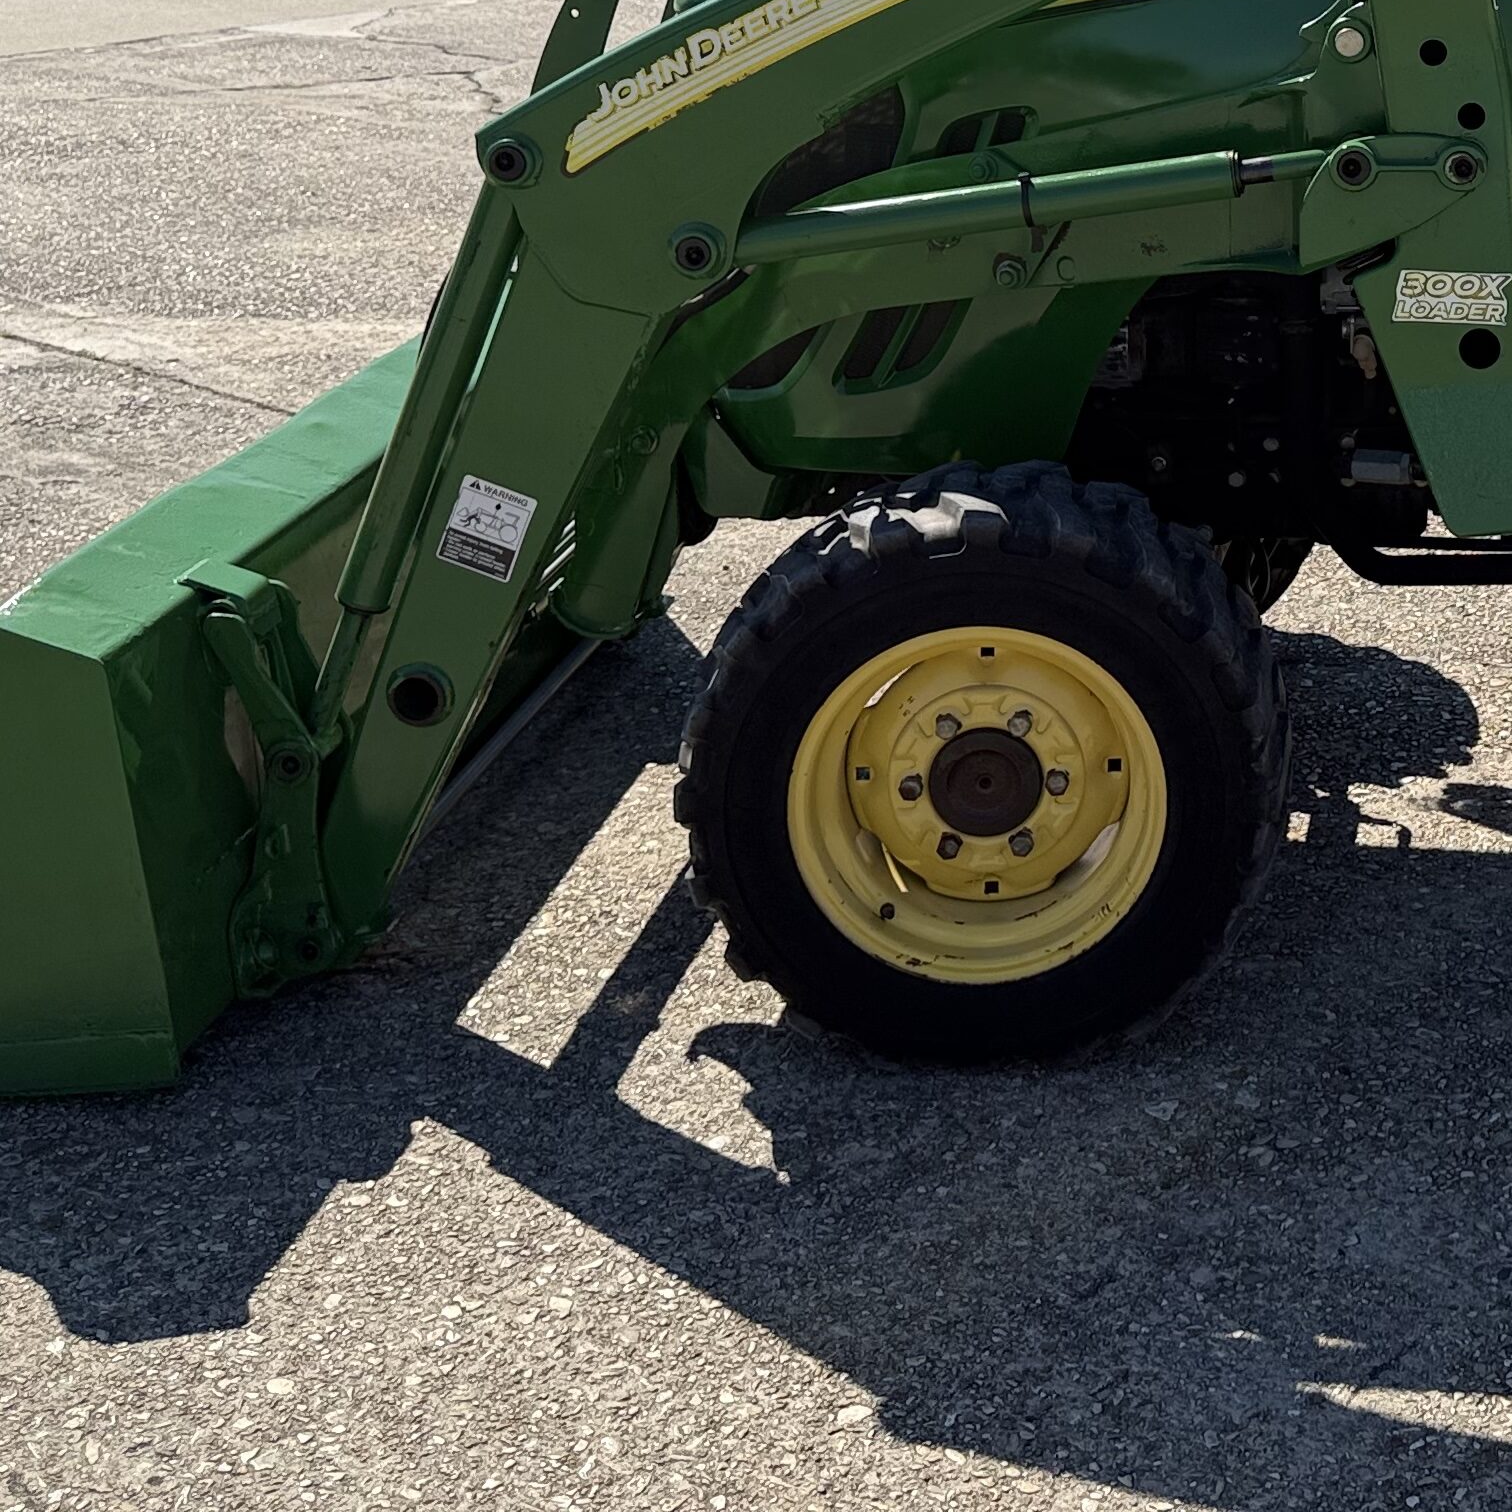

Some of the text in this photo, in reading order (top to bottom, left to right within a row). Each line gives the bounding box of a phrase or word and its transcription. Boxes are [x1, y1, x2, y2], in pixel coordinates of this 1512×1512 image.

[591, 47, 691, 122] JOHN
[1401, 271, 1511, 300] 300X
[1395, 300, 1505, 322] LOADER
[484, 485, 529, 507] WARNING
